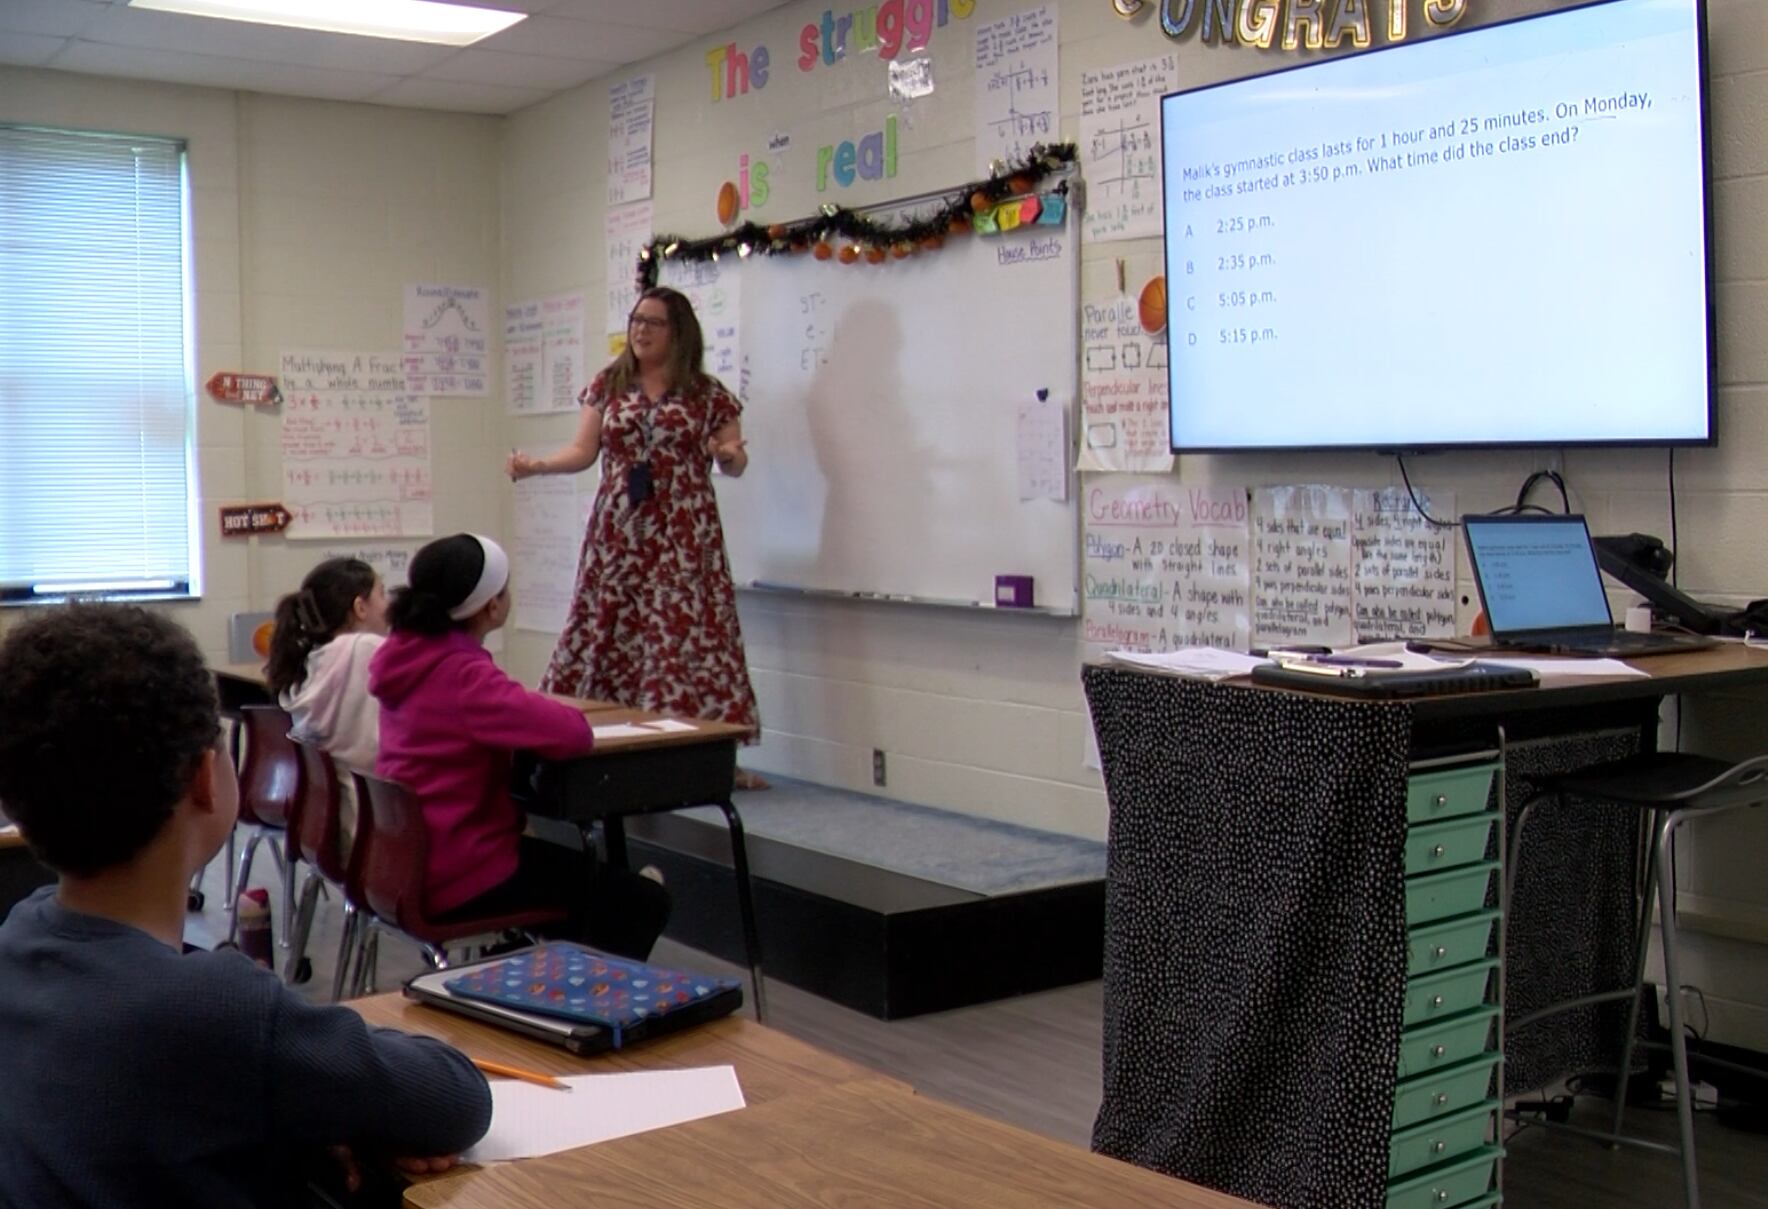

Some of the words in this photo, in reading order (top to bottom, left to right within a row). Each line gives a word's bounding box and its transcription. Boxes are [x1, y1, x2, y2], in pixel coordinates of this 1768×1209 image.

[705, 42, 770, 102] The
[1183, 162, 1220, 181] Malik's
[1223, 153, 1284, 179] gymnastic
[1288, 147, 1318, 164] class
[1322, 141, 1352, 158] lasts
[1356, 136, 1375, 151] for
[1380, 134, 1386, 149] 1
[1392, 129, 1425, 147] hour
[1429, 121, 1455, 139] and
[1460, 118, 1479, 135] 25
[1484, 108, 1549, 131] minutes.
[1555, 102, 1578, 119] On
[1584, 91, 1652, 115] Monday,
[739, 153, 770, 209] is
[816, 113, 897, 192] real
[1183, 189, 1201, 203] the
[1205, 182, 1233, 199] class
[1236, 174, 1279, 194] started
[1282, 172, 1295, 187] at
[1299, 167, 1329, 184] 3:50
[1333, 164, 1362, 182] p.m.
[1367, 154, 1403, 173] What
[1406, 149, 1439, 168] time
[1443, 143, 1465, 162] did
[1470, 140, 1494, 158] the
[1499, 136, 1537, 154] class
[1541, 126, 1579, 146] end?
[1185, 224, 1193, 238] A
[1216, 216, 1244, 233] 2:25
[1248, 216, 1275, 232] p.m.
[1030, 237, 1063, 258] Points
[1186, 260, 1194, 274] B
[1218, 254, 1245, 271] 2:35
[1249, 254, 1276, 270] p.m.
[1186, 296, 1195, 311] C
[1219, 291, 1246, 307] 5:05
[1250, 291, 1277, 307] p.m.
[1084, 302, 1135, 323] Paralle
[1188, 332, 1197, 346] D
[1220, 328, 1247, 343] 5:15
[1251, 328, 1278, 344] p.m.
[1089, 488, 1181, 527] Geometry
[1188, 487, 1246, 524] Vocab
[224, 513, 249, 529] HOT
[1256, 516, 1264, 533] 4
[1354, 511, 1364, 531] 4
[1169, 536, 1202, 557] closed
[1208, 536, 1239, 560] shape
[1267, 540, 1290, 559] right
[1296, 540, 1329, 562] angles
[1418, 536, 1446, 553] equal
[1132, 557, 1154, 571] with
[1424, 567, 1451, 581] sides
[1188, 582, 1218, 609] shape
[1221, 589, 1244, 607] with
[1108, 601, 1116, 615] 4
[1118, 601, 1141, 616] sides
[1146, 603, 1164, 618] and
[1170, 605, 1179, 620] 4
[1185, 606, 1219, 626] angles
[1172, 631, 1237, 650] quadrilateral
